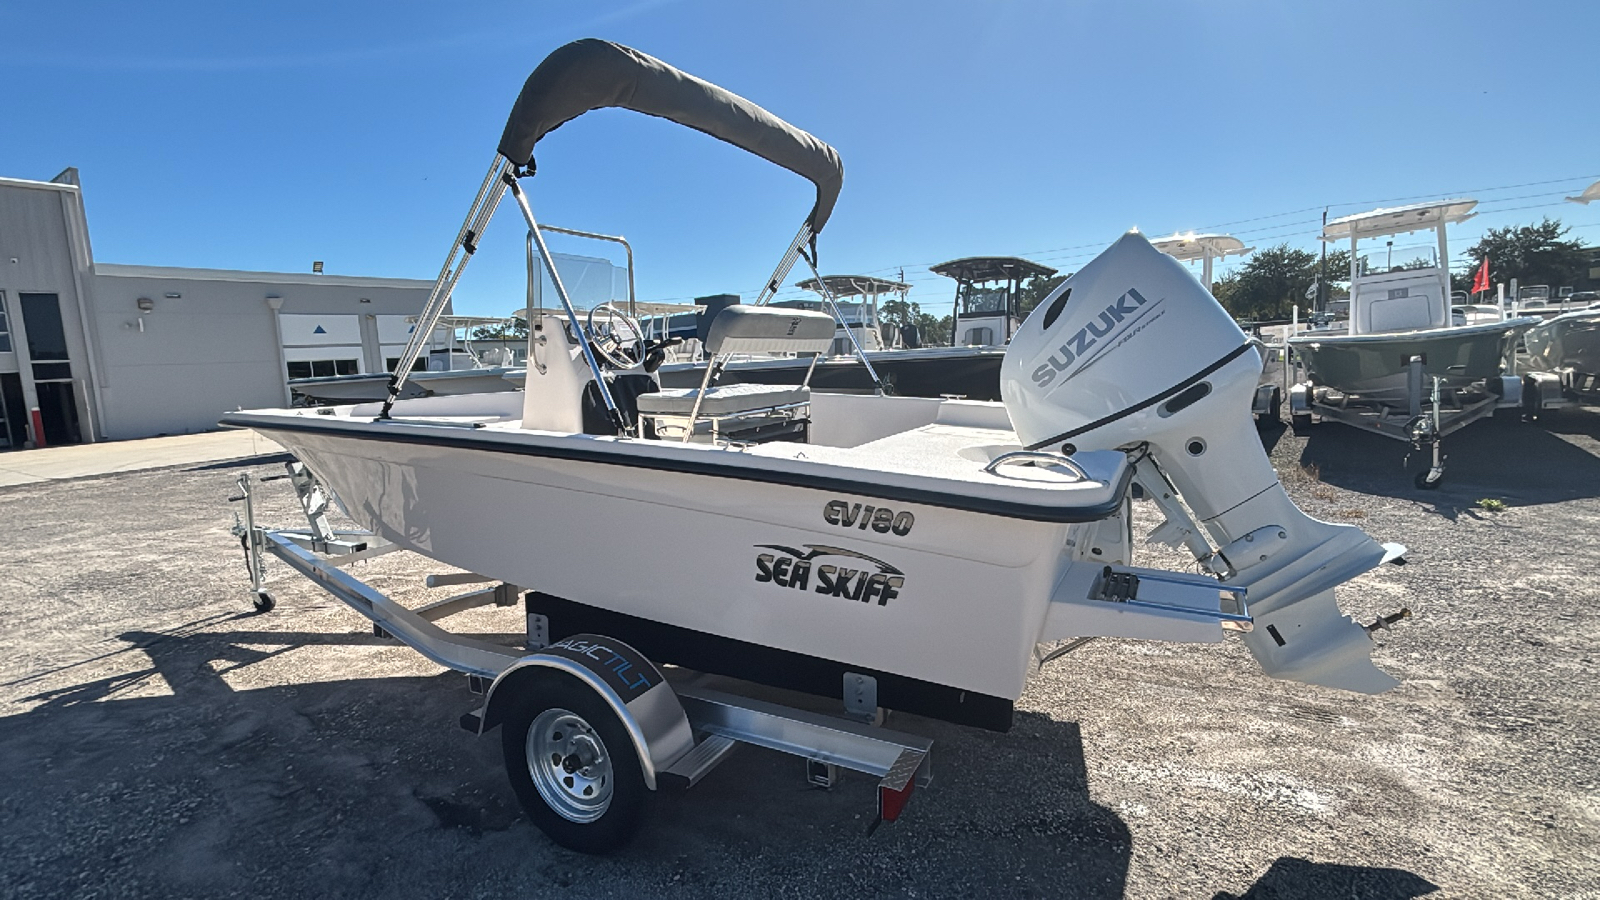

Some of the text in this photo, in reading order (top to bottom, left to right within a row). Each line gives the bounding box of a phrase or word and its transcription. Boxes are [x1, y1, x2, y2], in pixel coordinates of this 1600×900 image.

[1031, 287, 1148, 388] SUZUKI
[823, 500, 915, 536] EV180
[755, 553, 905, 607] SEA SKIFF
[551, 639, 652, 690] AGICTILT
